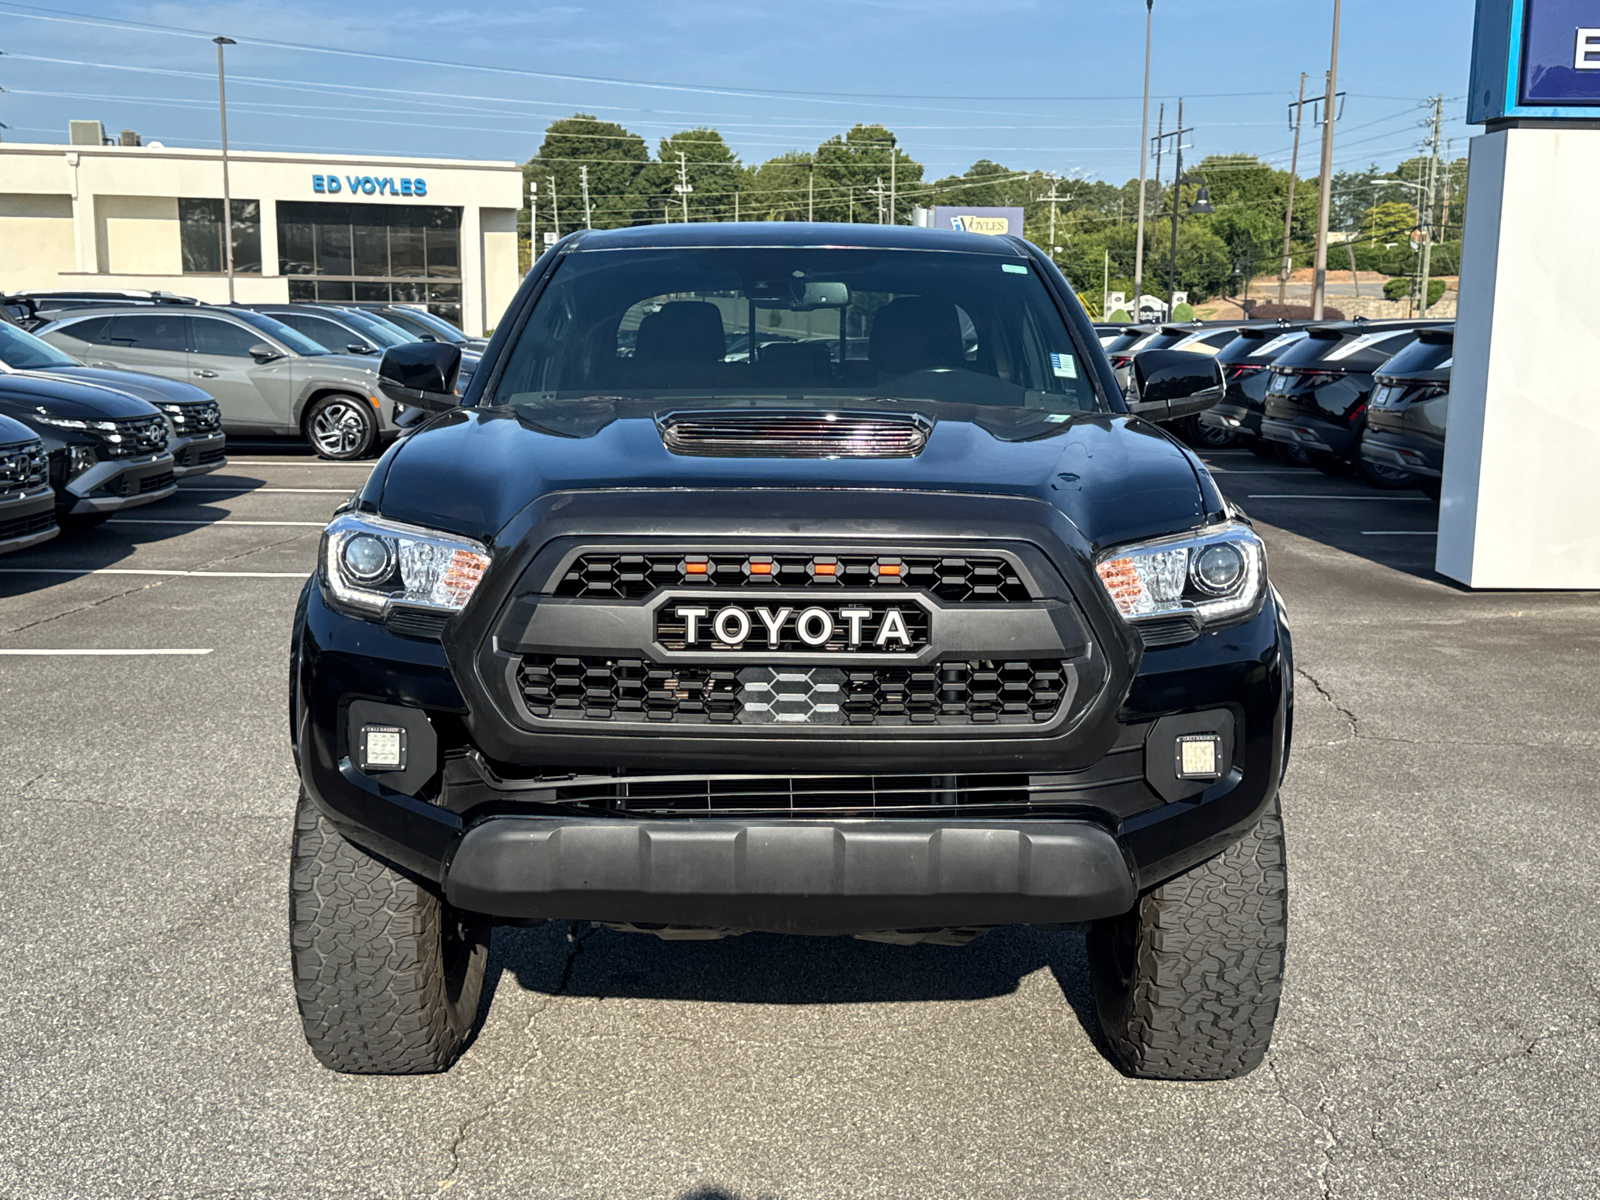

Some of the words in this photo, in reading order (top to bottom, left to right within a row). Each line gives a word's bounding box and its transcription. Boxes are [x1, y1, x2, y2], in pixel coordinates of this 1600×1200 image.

[312, 174, 342, 194] ED
[345, 175, 427, 197] VOYLES
[675, 605, 914, 647] TOYOTA
